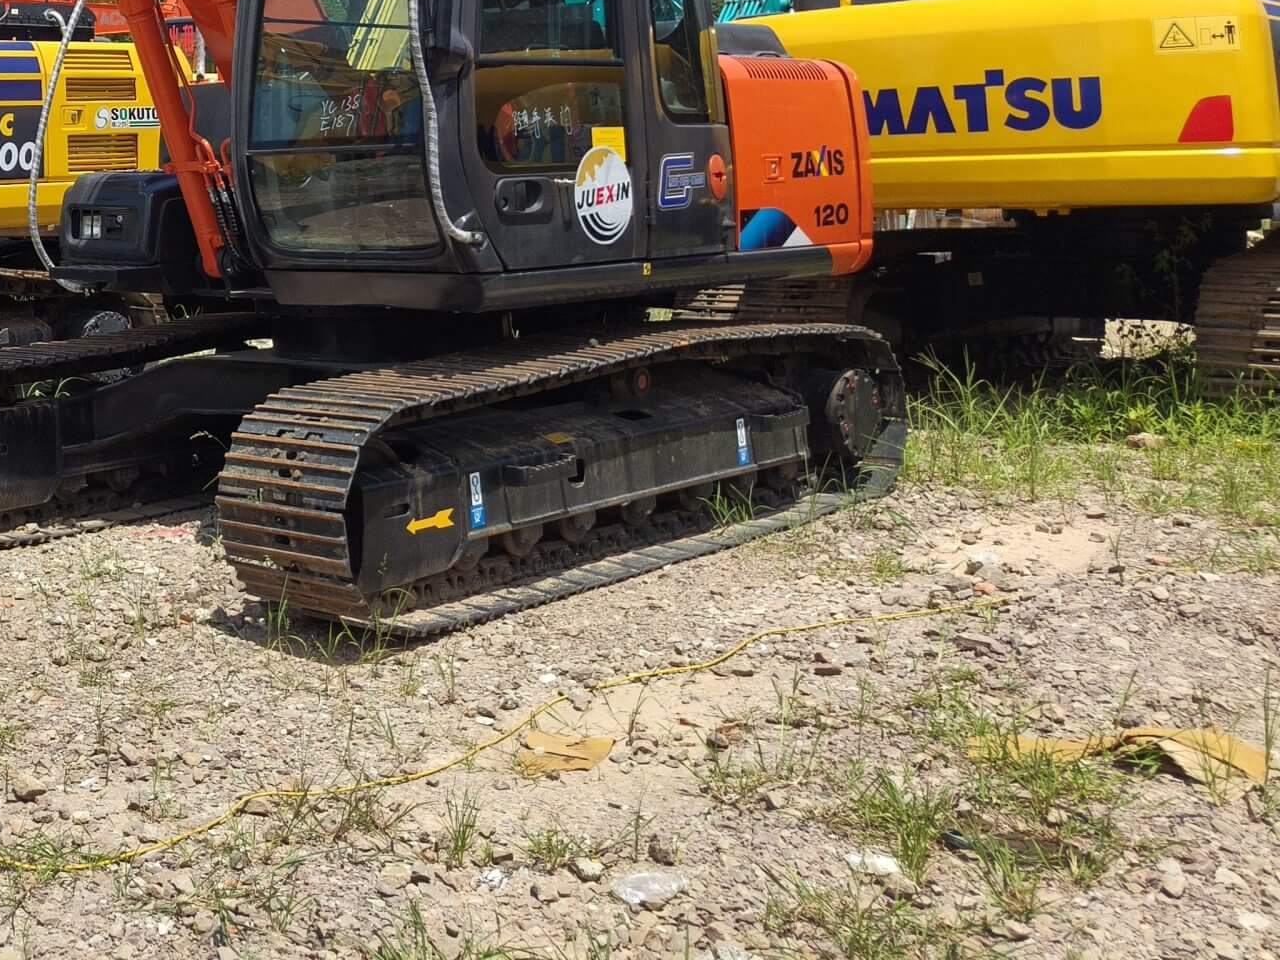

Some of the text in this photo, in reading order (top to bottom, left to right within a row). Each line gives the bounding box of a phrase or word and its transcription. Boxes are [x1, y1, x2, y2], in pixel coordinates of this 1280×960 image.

[862, 69, 1102, 136] MATSU
[790, 144, 845, 178] ZAXIS
[577, 181, 630, 210] JUEXIN
[814, 202, 849, 228] 120
